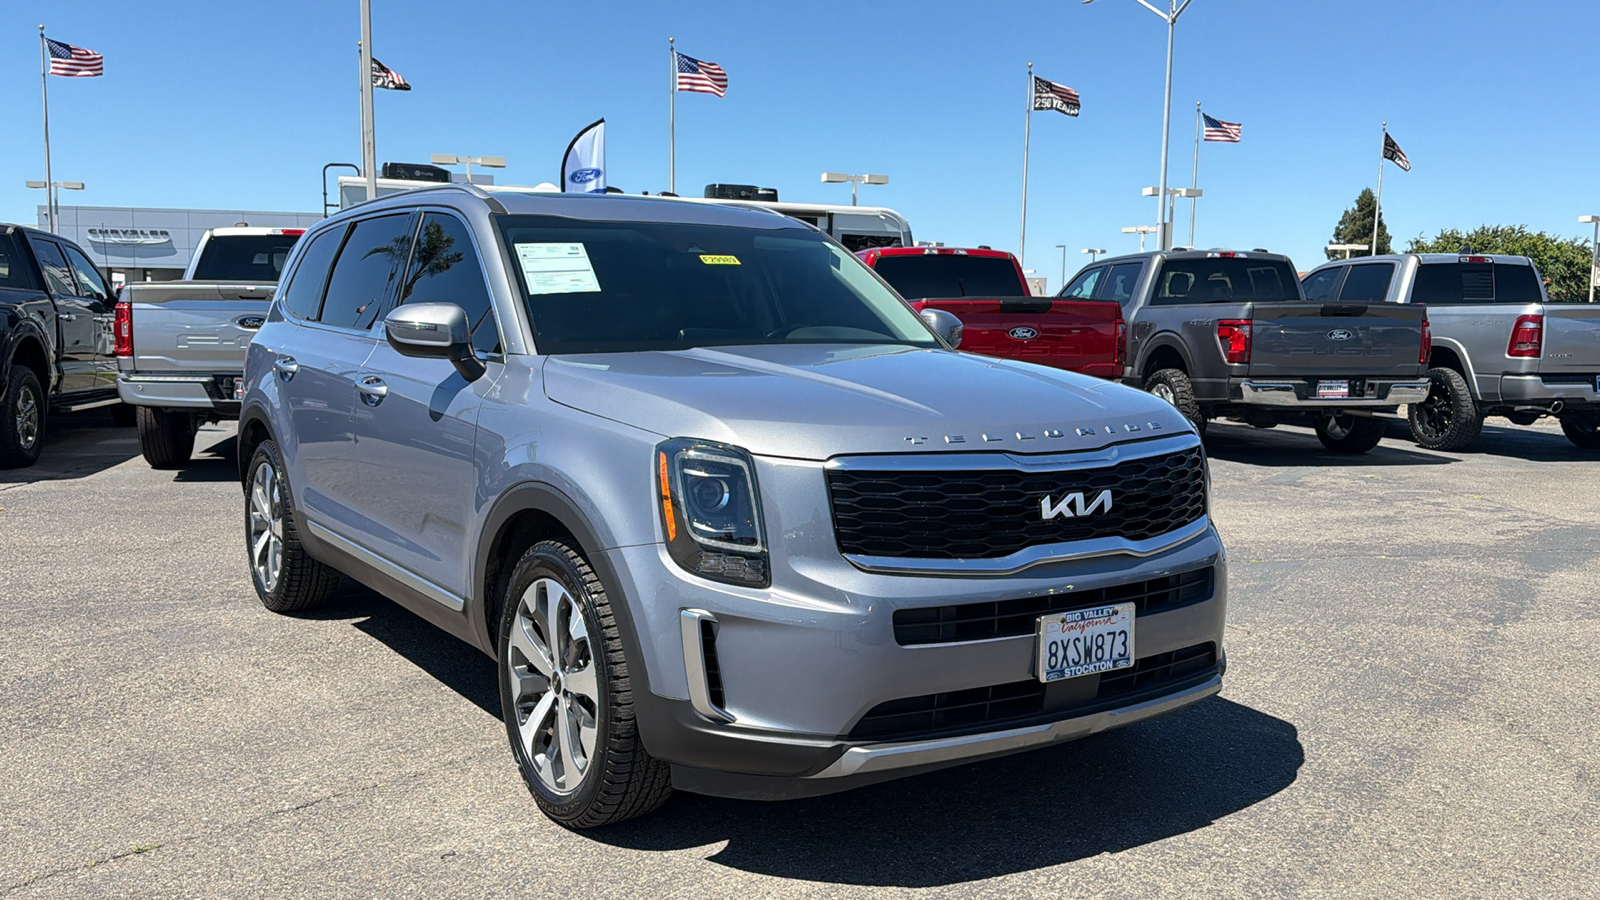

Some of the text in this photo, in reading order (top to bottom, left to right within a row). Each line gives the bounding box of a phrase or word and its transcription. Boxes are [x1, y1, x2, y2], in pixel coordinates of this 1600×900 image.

[1035, 98, 1079, 115] 250 YEARS
[574, 170, 596, 182] Ford
[87, 228, 170, 237] CHRYSLER
[243, 318, 264, 327] Ford
[1012, 326, 1034, 338] Ford
[1330, 329, 1349, 340] Ford
[1282, 346, 1391, 357] F-150
[903, 420, 1163, 445] TELLURIDE
[1041, 489, 1113, 519] KIA
[1065, 607, 1114, 622] BIG VALLEY
[1061, 616, 1117, 635] California
[1047, 629, 1128, 670] 8XSW873
[1064, 660, 1114, 678] STOCKTON
